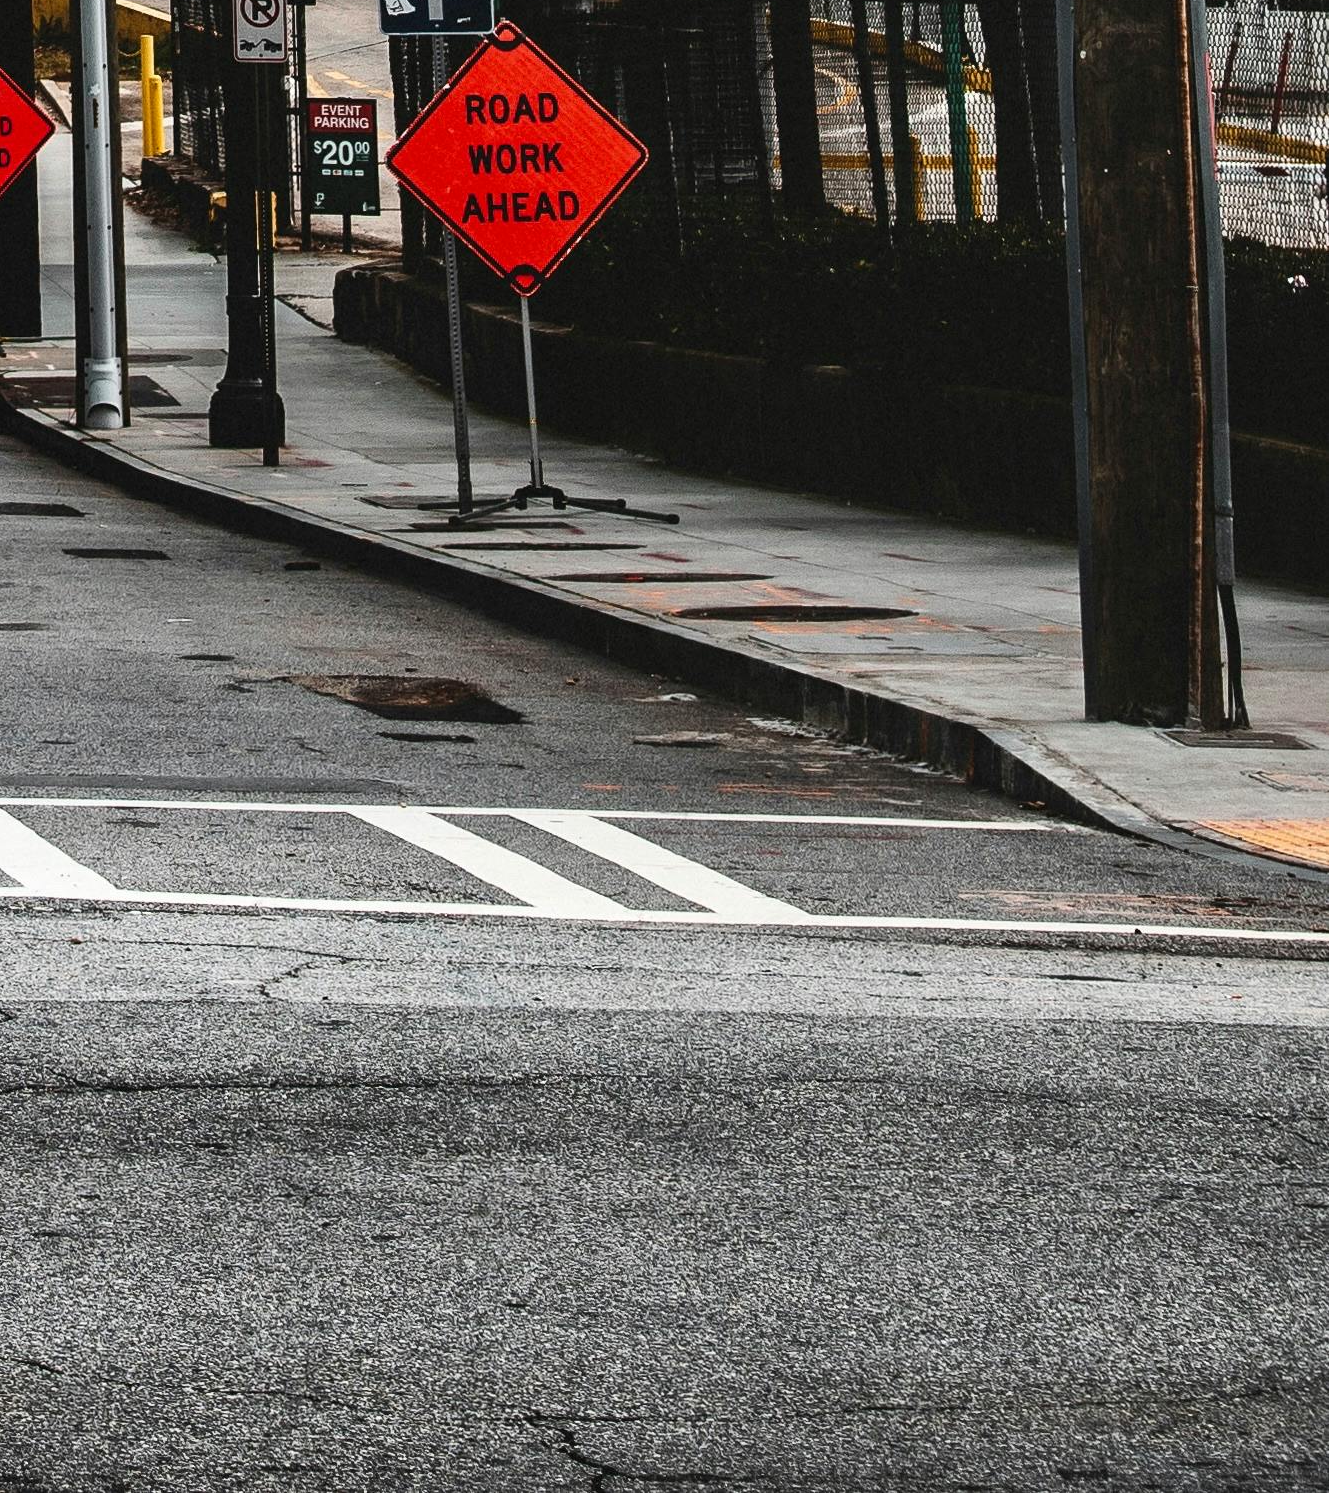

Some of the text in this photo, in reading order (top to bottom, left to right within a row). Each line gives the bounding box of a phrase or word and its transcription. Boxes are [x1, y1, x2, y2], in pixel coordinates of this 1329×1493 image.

[314, 117, 370, 129] PARKING
[321, 105, 362, 116] EVENT
[465, 92, 559, 125] ROAD
[469, 142, 564, 175] WORK
[462, 190, 580, 223] AHEAD
